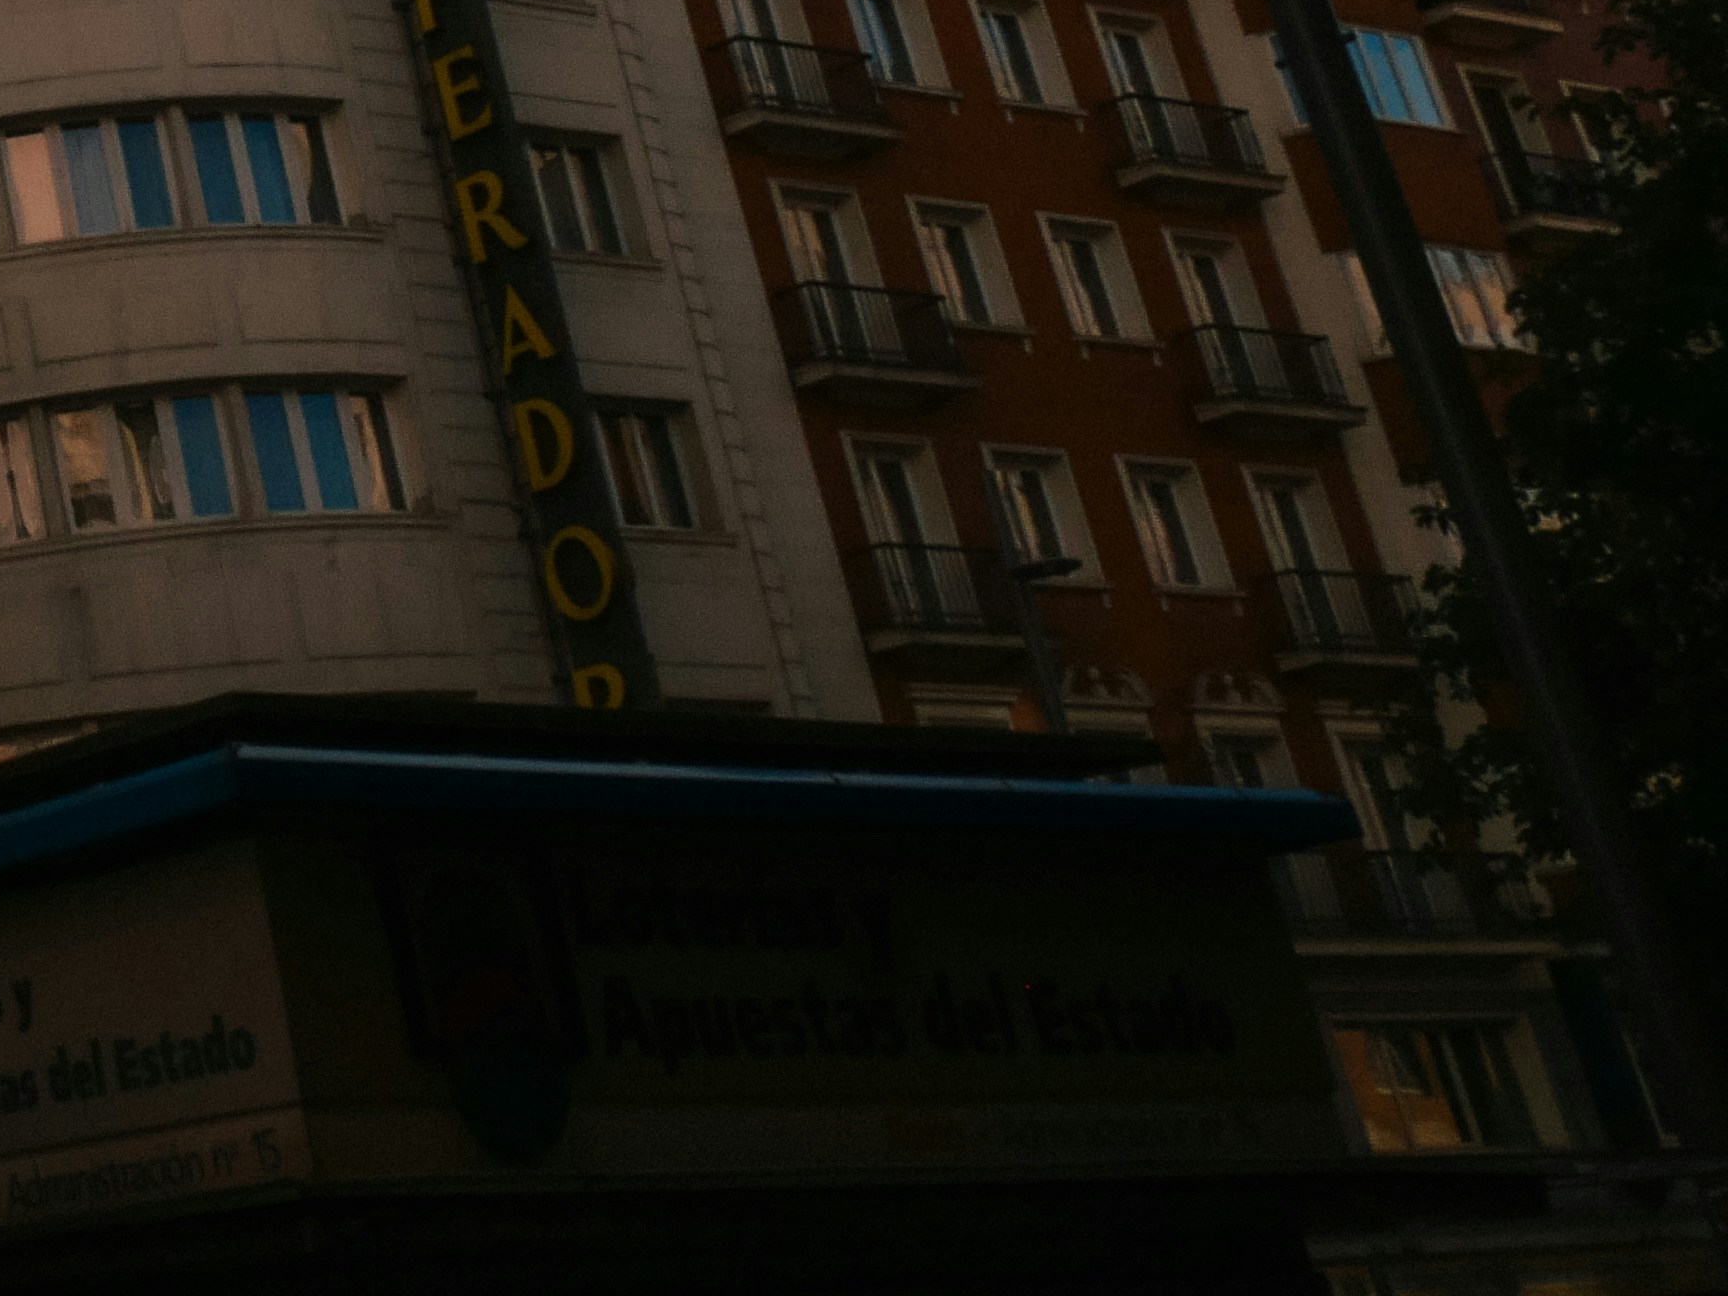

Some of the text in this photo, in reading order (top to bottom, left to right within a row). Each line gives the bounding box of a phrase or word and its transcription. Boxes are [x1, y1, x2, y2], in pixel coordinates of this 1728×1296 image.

[12, 976, 34, 1032] y
[603, 968, 1236, 1072] Apuestas del Estado
[48, 1037, 105, 1101] del
[113, 1014, 256, 1093] Estado
